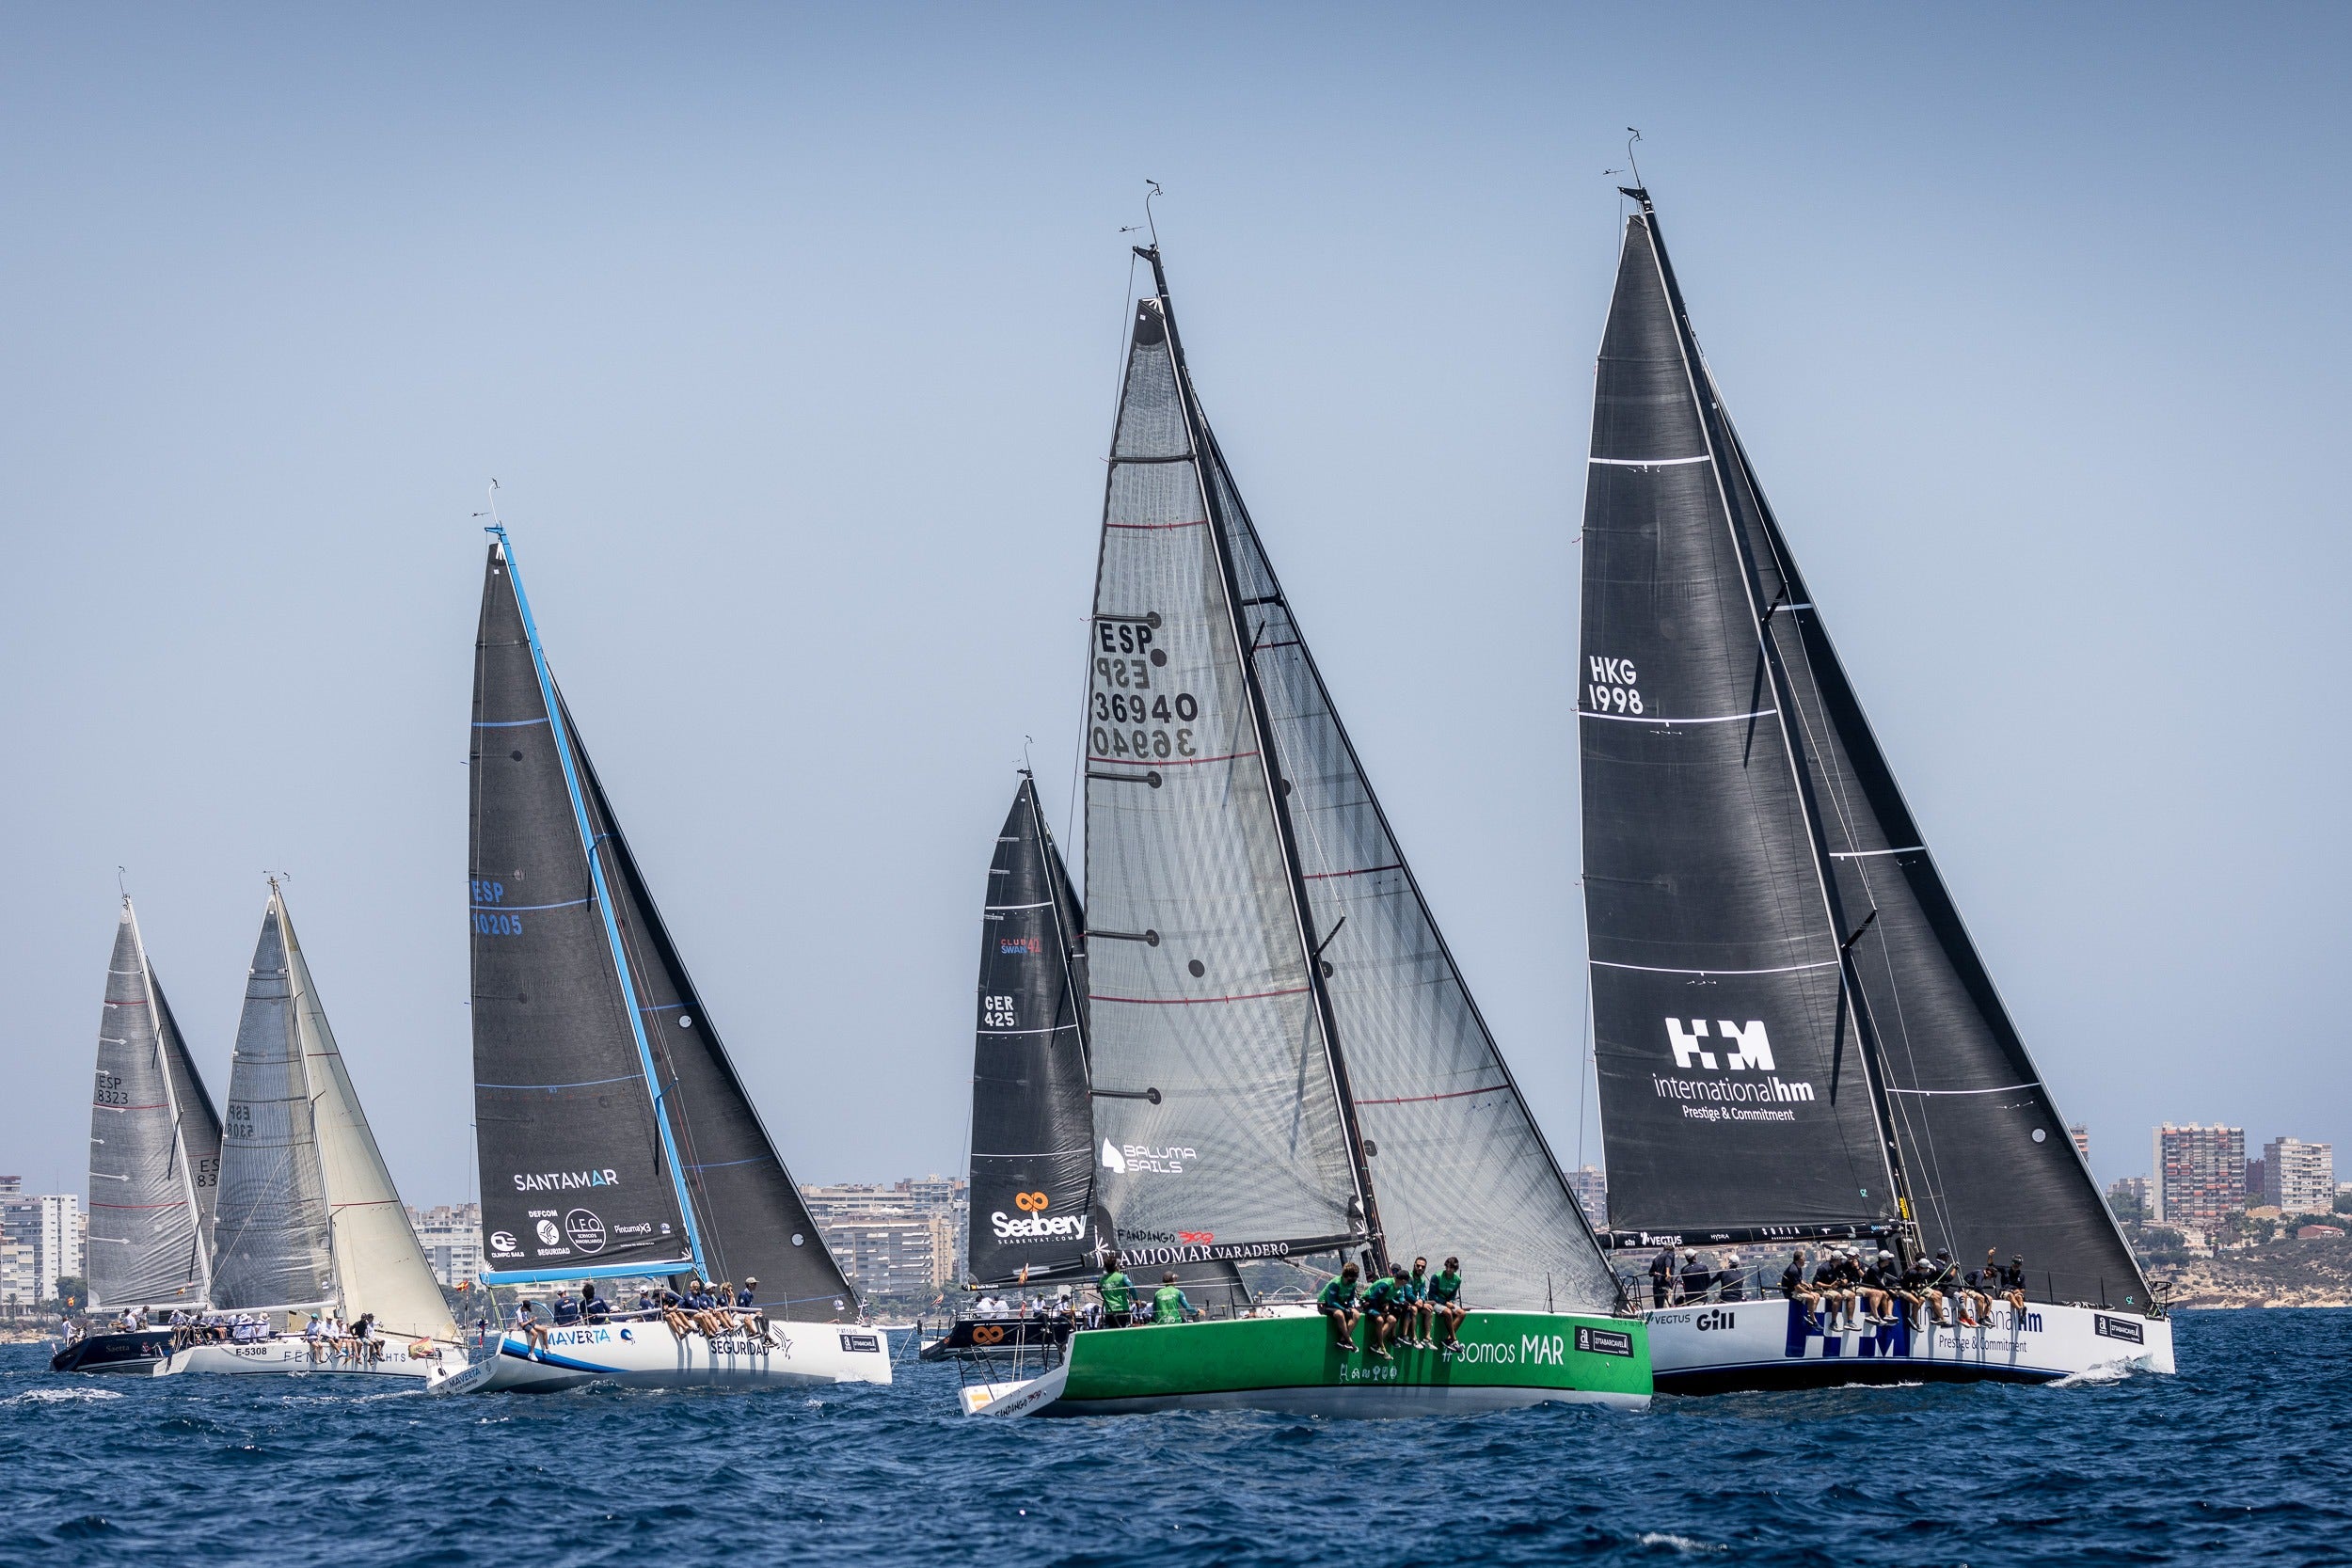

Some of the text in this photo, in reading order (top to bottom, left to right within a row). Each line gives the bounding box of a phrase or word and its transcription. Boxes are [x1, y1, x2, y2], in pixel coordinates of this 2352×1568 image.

[1099, 623, 1152, 655] ESP
[1589, 656, 1637, 685] HKG
[1588, 684, 1644, 715] 1998
[1094, 692, 1199, 724] 36940
[471, 880, 503, 903] ESP
[472, 913, 522, 935] 10205
[1001, 945, 1027, 954] SWAN
[985, 995, 1014, 1011] GER
[984, 1011, 1015, 1027] 425
[99, 1076, 122, 1089] ESP
[1652, 1073, 1815, 1102] internationalhm
[98, 1090, 129, 1104] 8323
[1682, 1104, 1796, 1121] Prestige & Commitment
[1123, 1145, 1197, 1160] BALUMA
[200, 1159, 221, 1172] ES
[1125, 1160, 1183, 1173] SAILS
[514, 1169, 620, 1191] SANTAMAR
[528, 1210, 559, 1218] DEFCOM
[991, 1212, 1088, 1241] Seabery
[1761, 1227, 1801, 1236] SOFIA
[1118, 1228, 1176, 1243] FANDANGO
[537, 1246, 571, 1257] SEGURIDAD
[1214, 1242, 1289, 1259] VARADERO
[1696, 1309, 1735, 1331] Gill
[235, 1347, 267, 1356] E-5308
[710, 1340, 770, 1355] SEGURIDAD
[1521, 1334, 1565, 1366] MAR
[1939, 1334, 2027, 1353] Prestige & Commitment
[361, 1353, 406, 1362] YAHTS
[448, 1368, 482, 1388] MAVERTA
